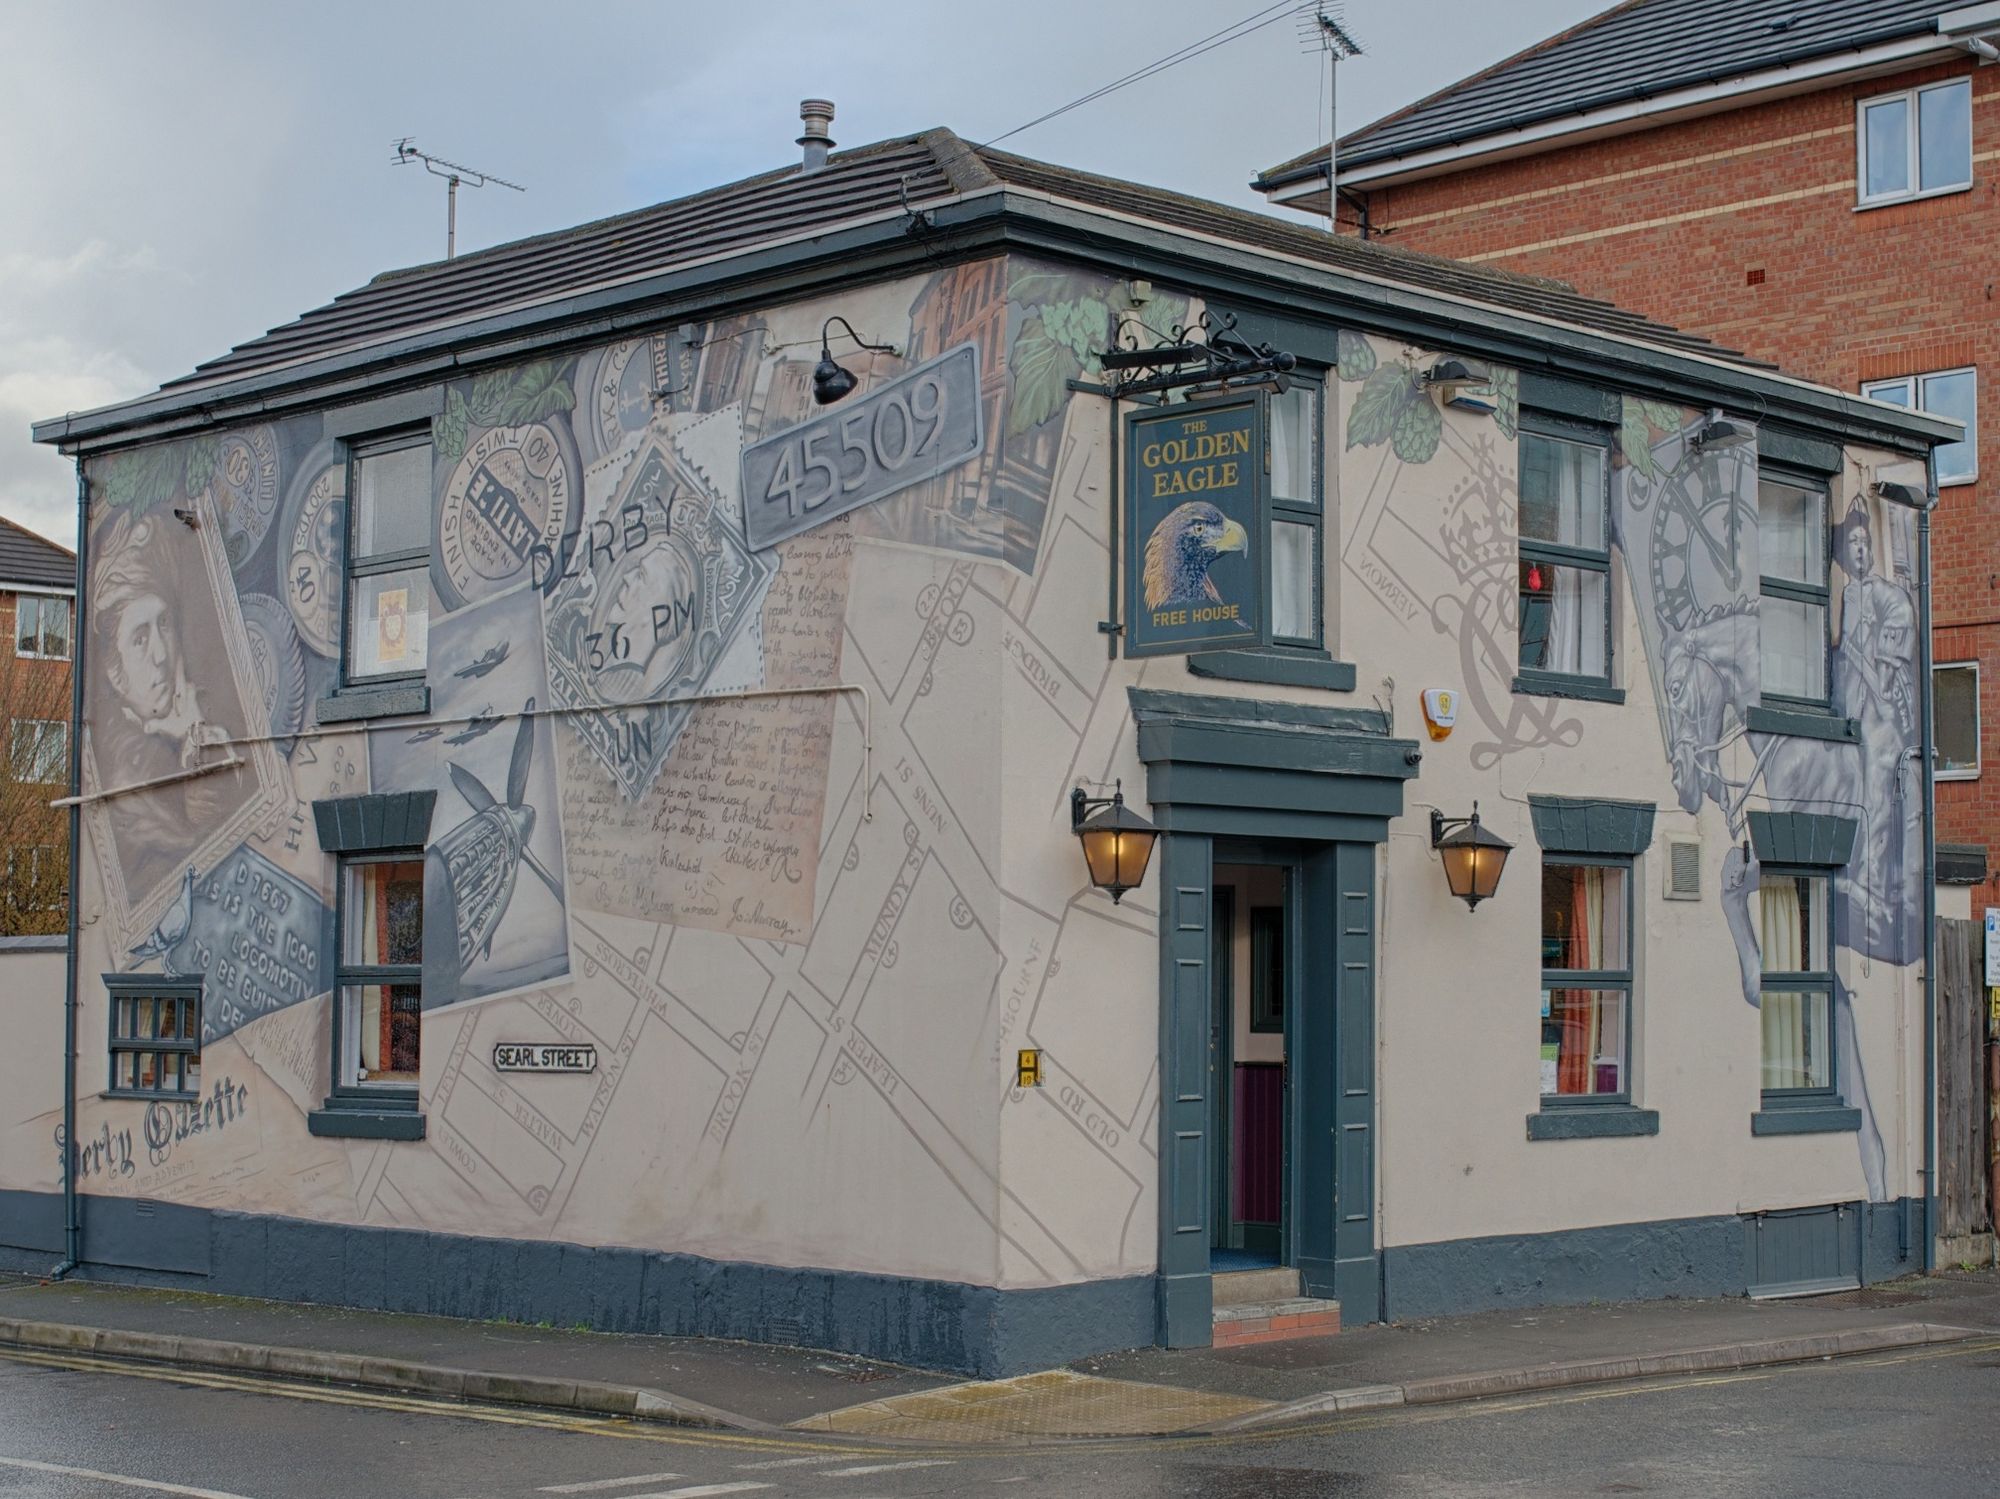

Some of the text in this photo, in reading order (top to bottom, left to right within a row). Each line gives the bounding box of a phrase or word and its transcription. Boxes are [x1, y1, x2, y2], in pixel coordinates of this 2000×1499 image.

[466, 427, 515, 475] TWIST
[529, 435, 550, 464] 40
[765, 373, 947, 518] 45509
[1142, 428, 1251, 468] GOLDEN
[1182, 420, 1207, 435] THE
[1151, 462, 1240, 498] EAGLE
[296, 476, 331, 546] 200 YDS
[529, 483, 680, 592] DERBY
[444, 494, 470, 592] FINISH
[296, 566, 316, 604] 40
[651, 591, 696, 644] PM
[1152, 604, 1240, 628] FREE HOUSE
[1000, 632, 1059, 700] BRIDGE
[911, 785, 948, 834] NUNS
[236, 861, 289, 914] D 7667
[223, 892, 242, 915] IS
[250, 905, 275, 945] THE
[286, 932, 316, 971] 1000
[193, 939, 210, 968] TO
[217, 958, 238, 989] BE
[497, 1047, 594, 1070] SEARL STREET
[846, 1031, 901, 1098] LEAPER
[143, 1076, 247, 1168] Gazette
[513, 1102, 564, 1153] WALTER
[707, 1059, 752, 1145] BROOK
[1059, 1086, 1120, 1149] OLD RD
